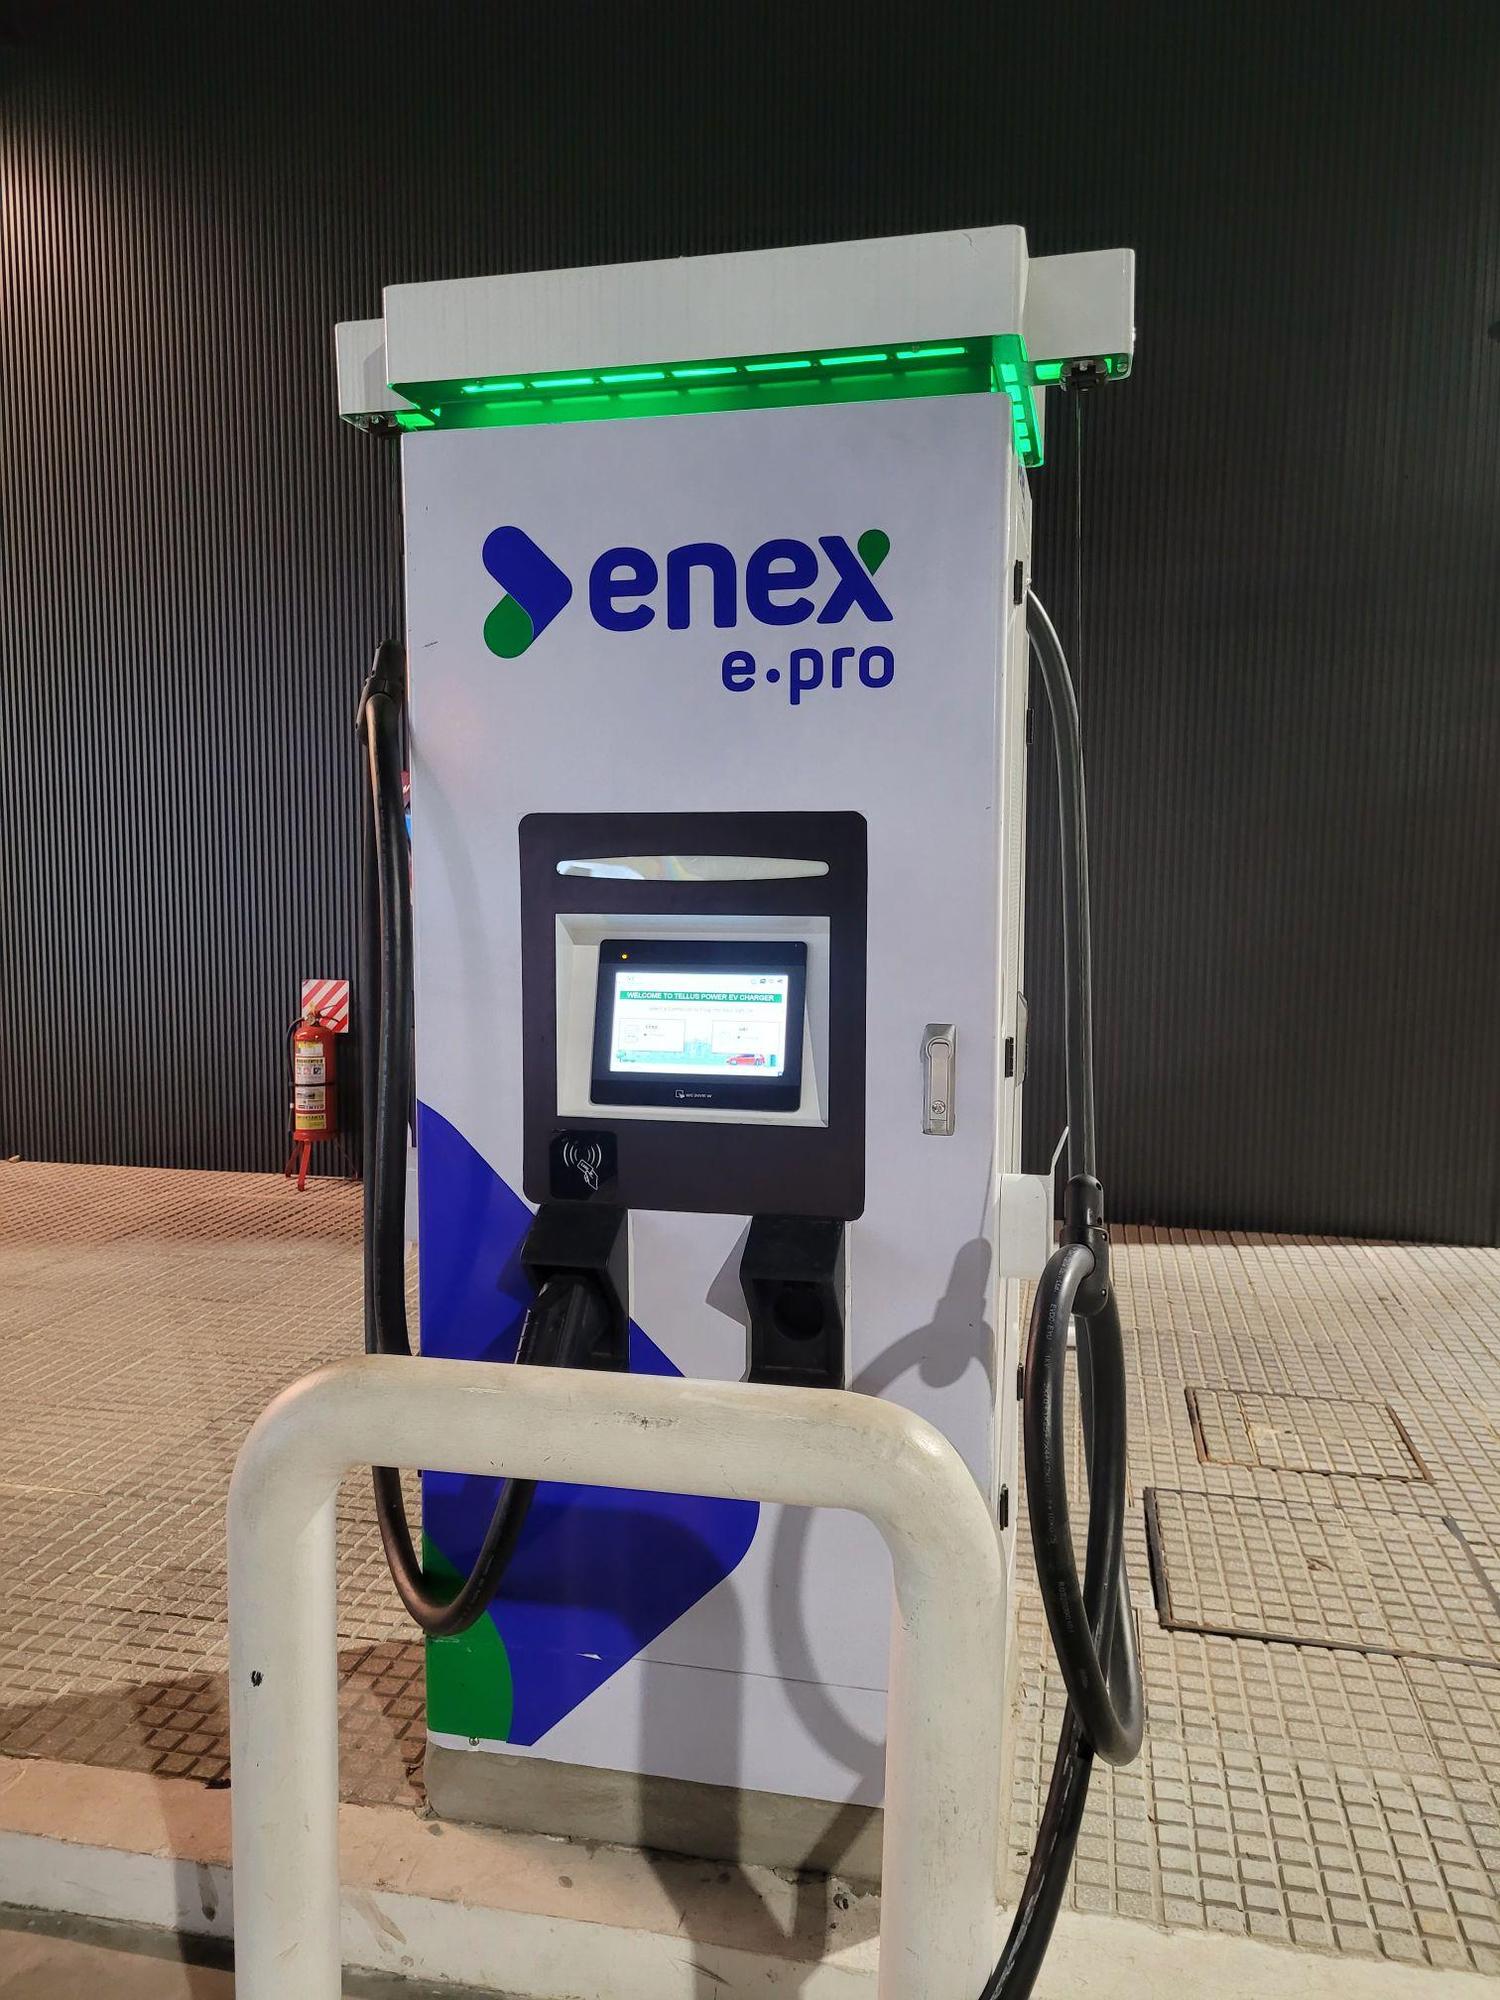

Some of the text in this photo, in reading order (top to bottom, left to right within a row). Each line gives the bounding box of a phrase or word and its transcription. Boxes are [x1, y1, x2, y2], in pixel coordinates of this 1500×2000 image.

[589, 529, 894, 632] enex
[626, 991, 663, 999] WELCOME
[663, 992, 673, 1000] TO
[674, 992, 700, 1000] TELLUS
[700, 993, 728, 1001] POWER
[739, 994, 775, 1002] CHARGER
